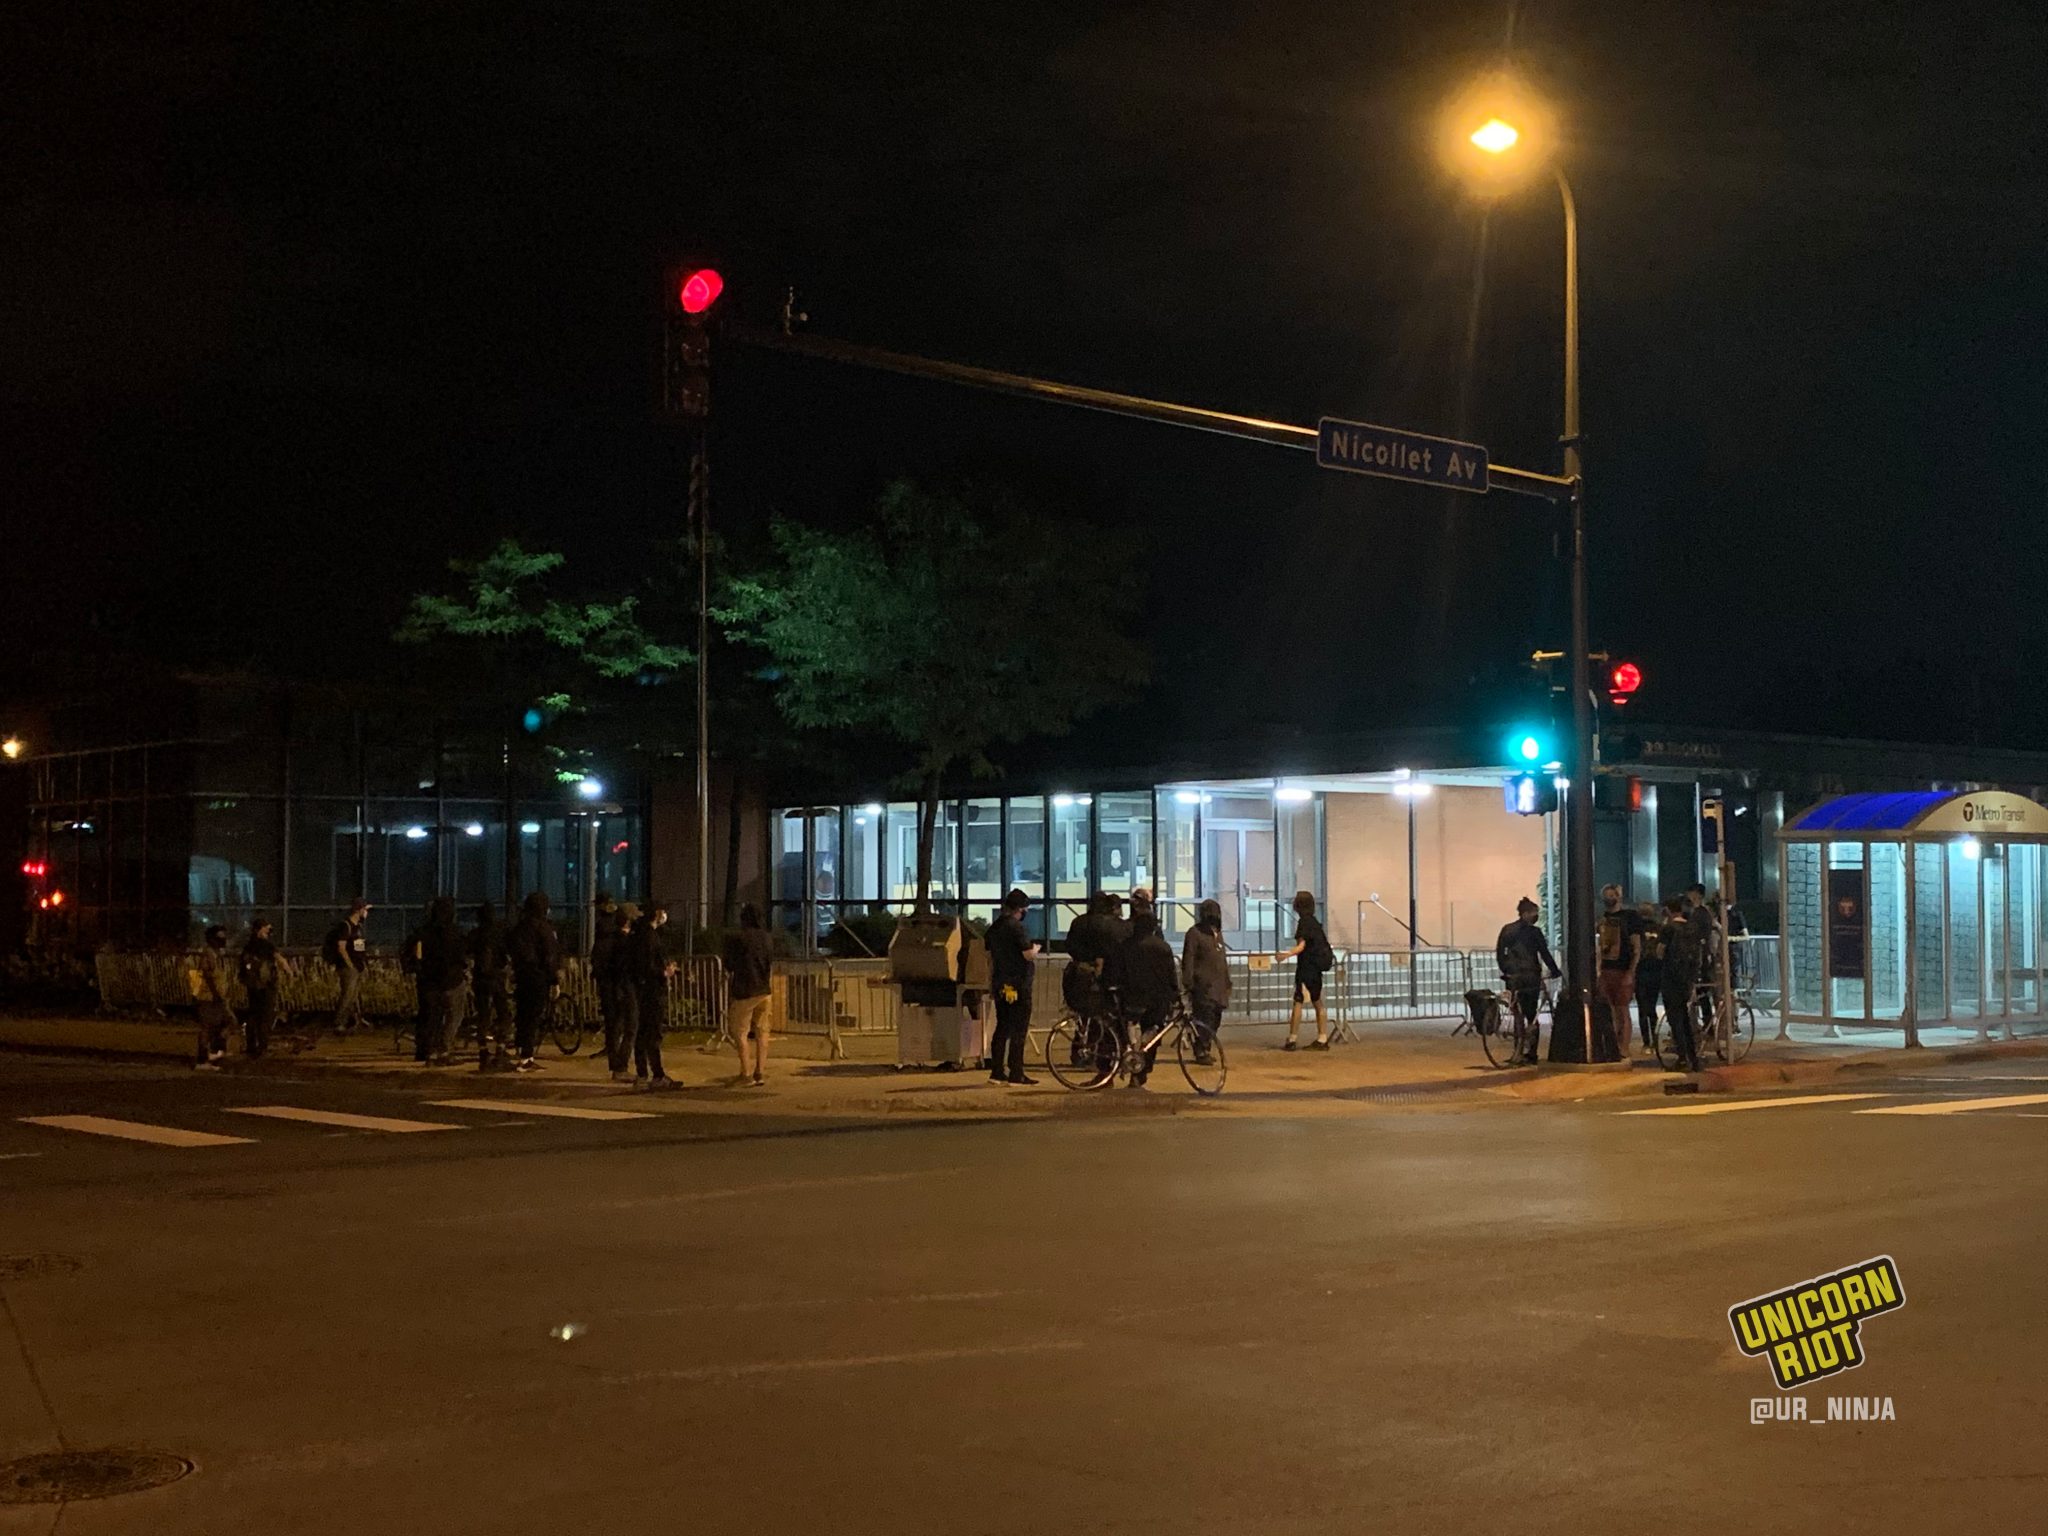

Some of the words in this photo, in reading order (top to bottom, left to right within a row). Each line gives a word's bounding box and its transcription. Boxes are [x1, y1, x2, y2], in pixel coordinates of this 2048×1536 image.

[1331, 430, 1432, 473] Nicollet
[1446, 451, 1477, 480] Av
[1975, 804, 2000, 821] Metro
[2000, 804, 2026, 821] Transit
